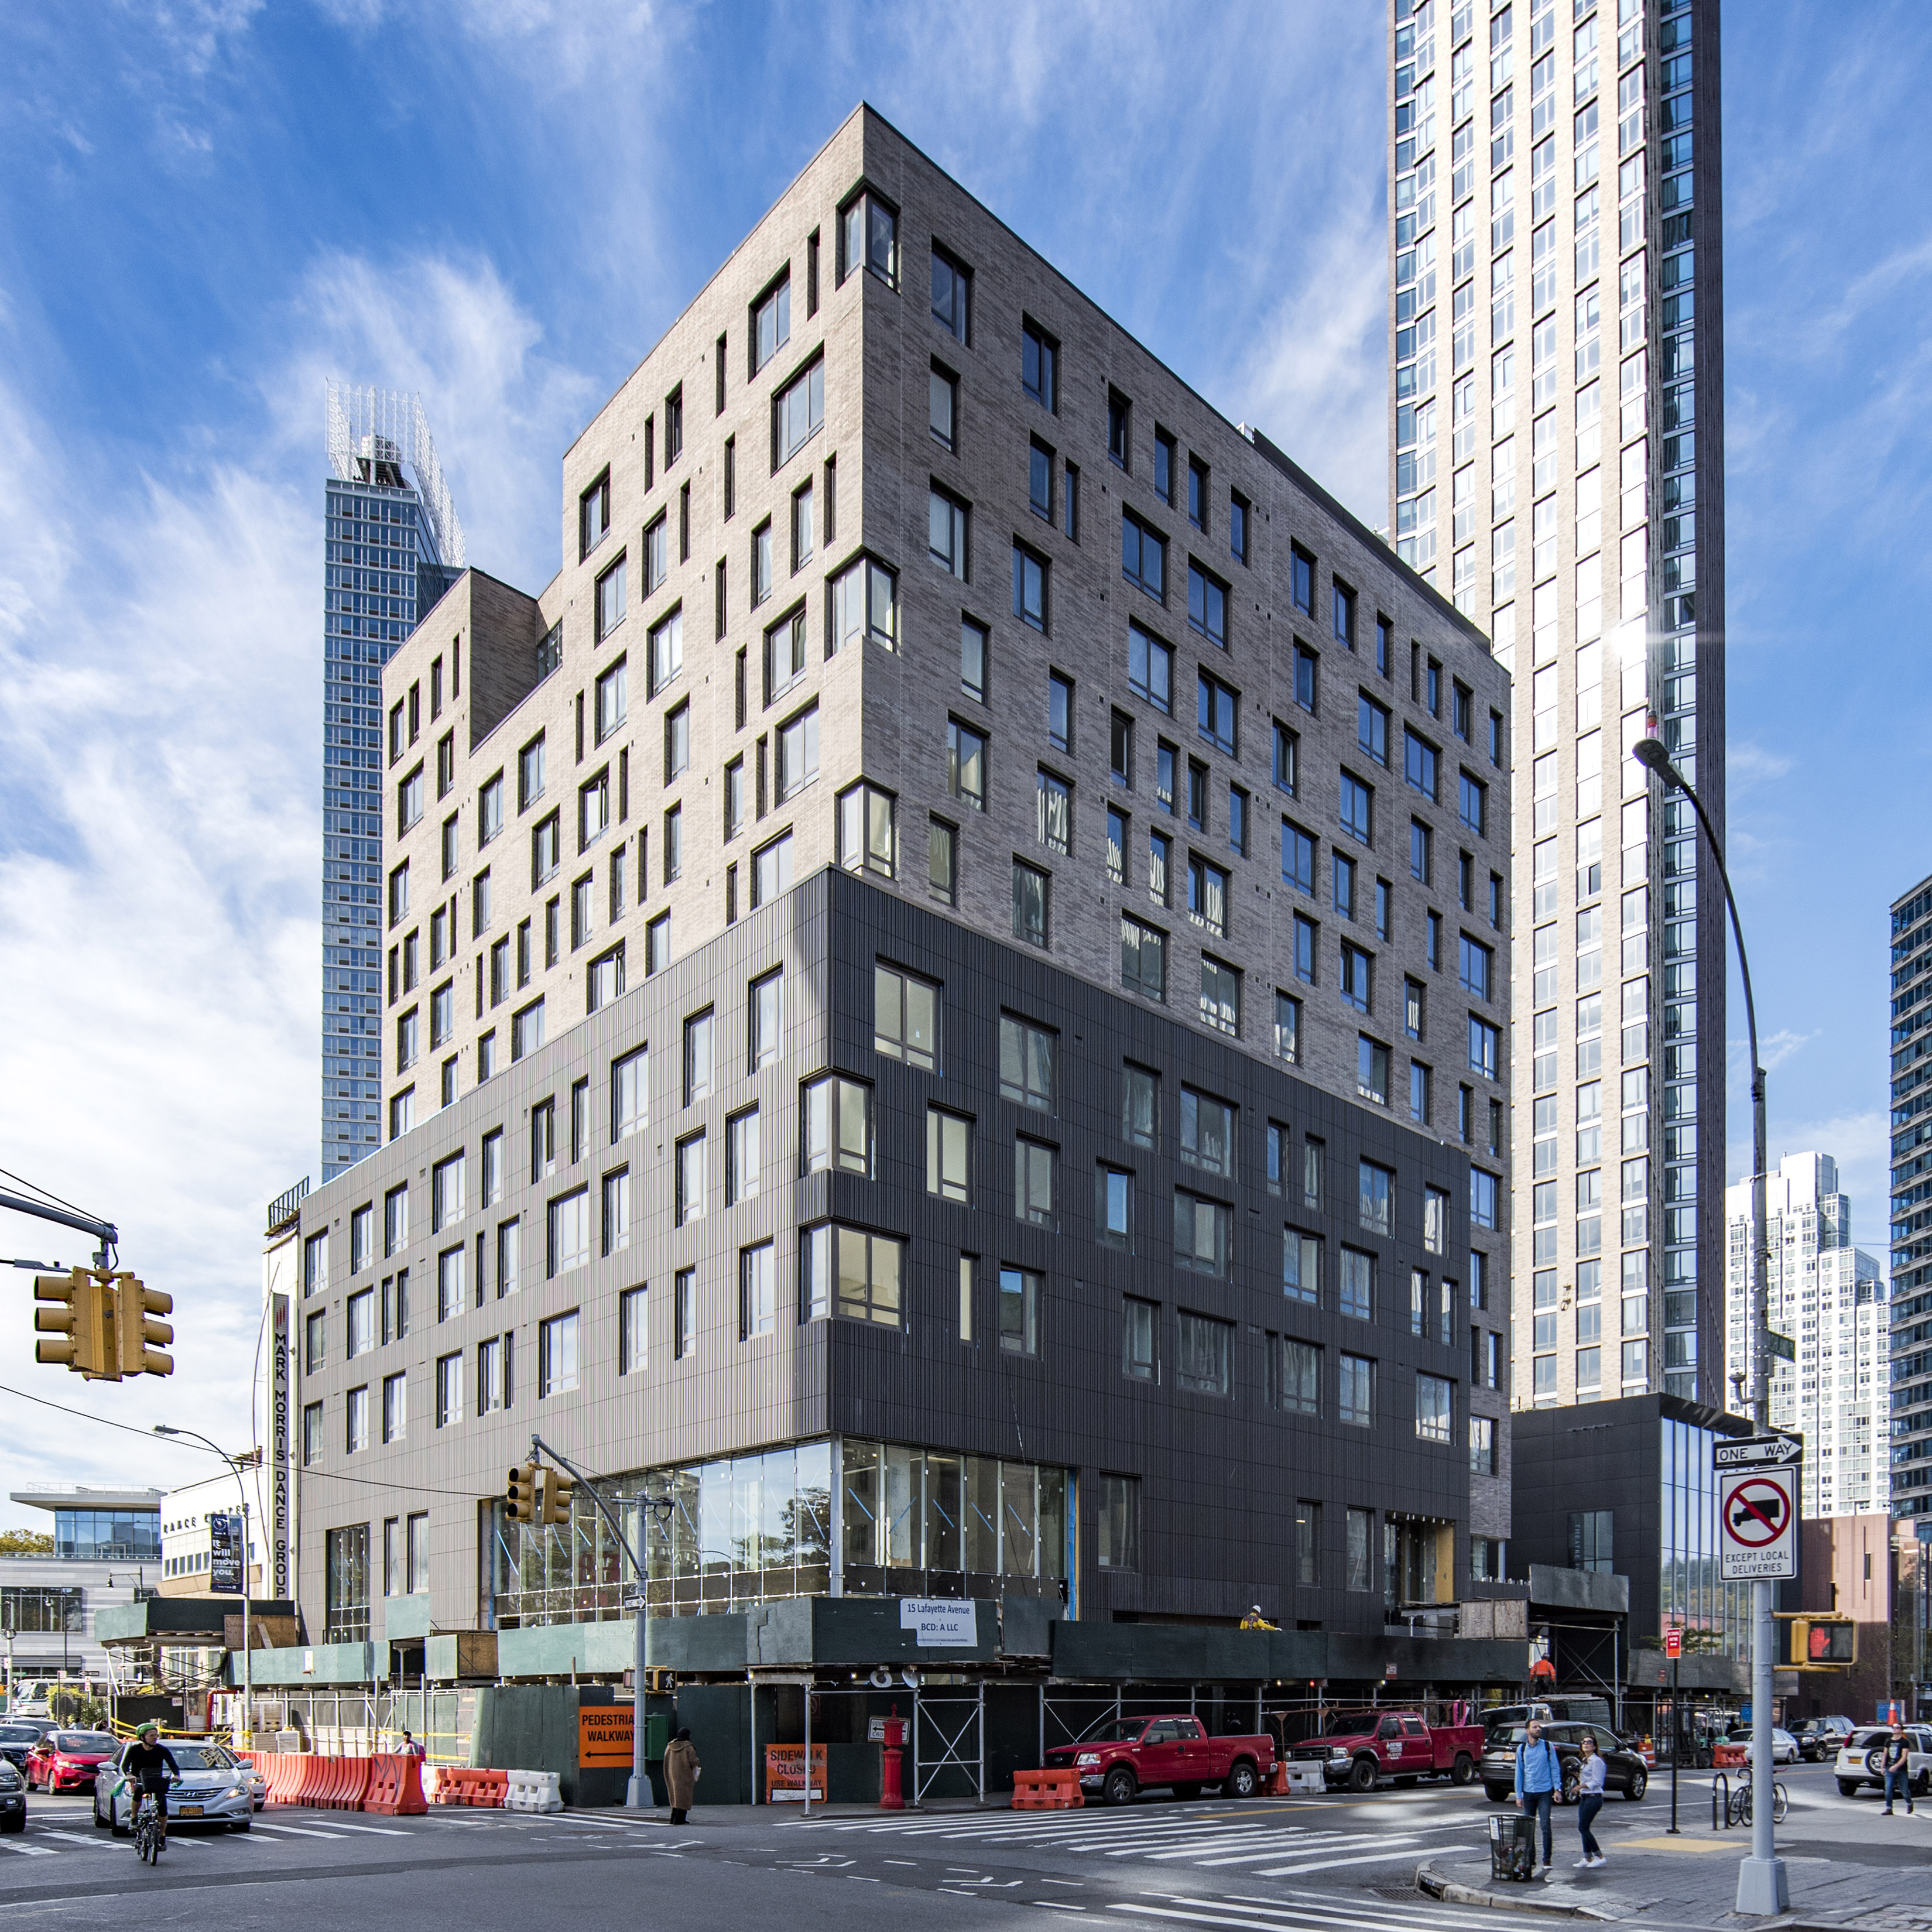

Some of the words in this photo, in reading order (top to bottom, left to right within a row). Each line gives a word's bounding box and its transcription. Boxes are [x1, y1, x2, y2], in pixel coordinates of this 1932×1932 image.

[275, 1333, 286, 1381] MARK
[275, 1390, 286, 1461] MORRIS
[1719, 1448, 1748, 1461] ONE
[1764, 1443, 1793, 1457] WAY
[275, 1471, 286, 1529] DANCE
[213, 1558, 240, 1567] move
[1725, 1553, 1757, 1563] EXCEPT
[1760, 1551, 1789, 1560] LOCAL
[276, 1540, 286, 1598] GROUP
[1732, 1563, 1782, 1574] DELIVERIES
[907, 1604, 916, 1612] 15
[917, 1604, 946, 1615] Lafayette
[947, 1605, 970, 1614] Avenue
[921, 1623, 938, 1631] BCD:
[582, 1714, 635, 1726] PEDESTRIA
[770, 1749, 823, 1761] SIDEWLK
[777, 1763, 816, 1775] CLOSD
